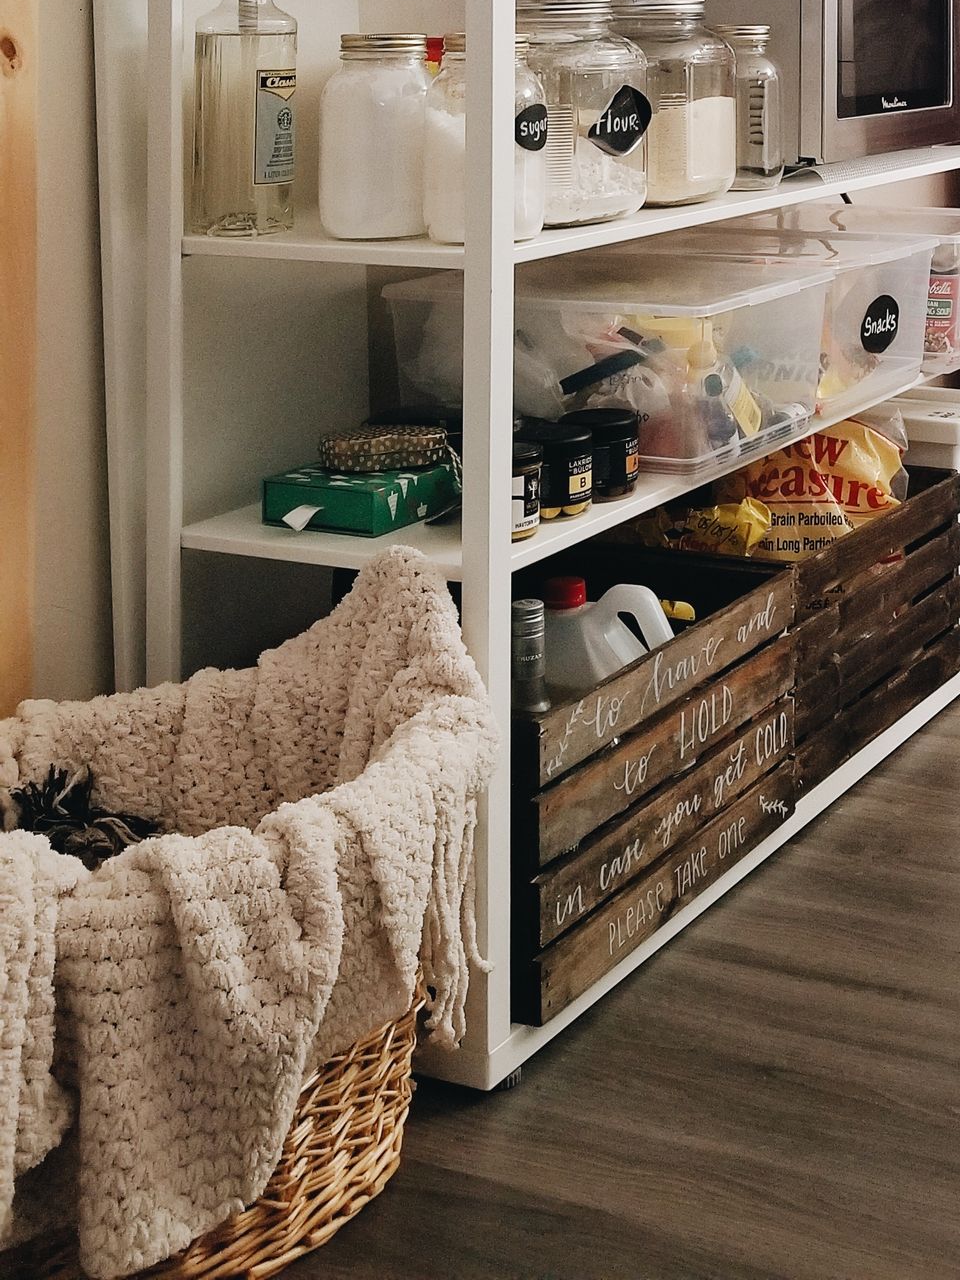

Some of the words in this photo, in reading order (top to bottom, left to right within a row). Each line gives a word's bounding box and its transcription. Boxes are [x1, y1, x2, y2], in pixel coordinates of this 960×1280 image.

[863, 308, 897, 337] Snacks
[579, 476, 587, 489] B
[770, 512, 796, 527] Grain
[797, 511, 843, 527] Parboiled
[776, 535, 801, 553] Long
[583, 690, 631, 738] to
[640, 636, 725, 715] have
[736, 591, 777, 644] and
[613, 743, 657, 796] to
[679, 684, 733, 760] HOLD
[554, 884, 586, 927] in
[599, 837, 646, 891] case
[654, 793, 703, 848] you
[713, 740, 749, 809] get
